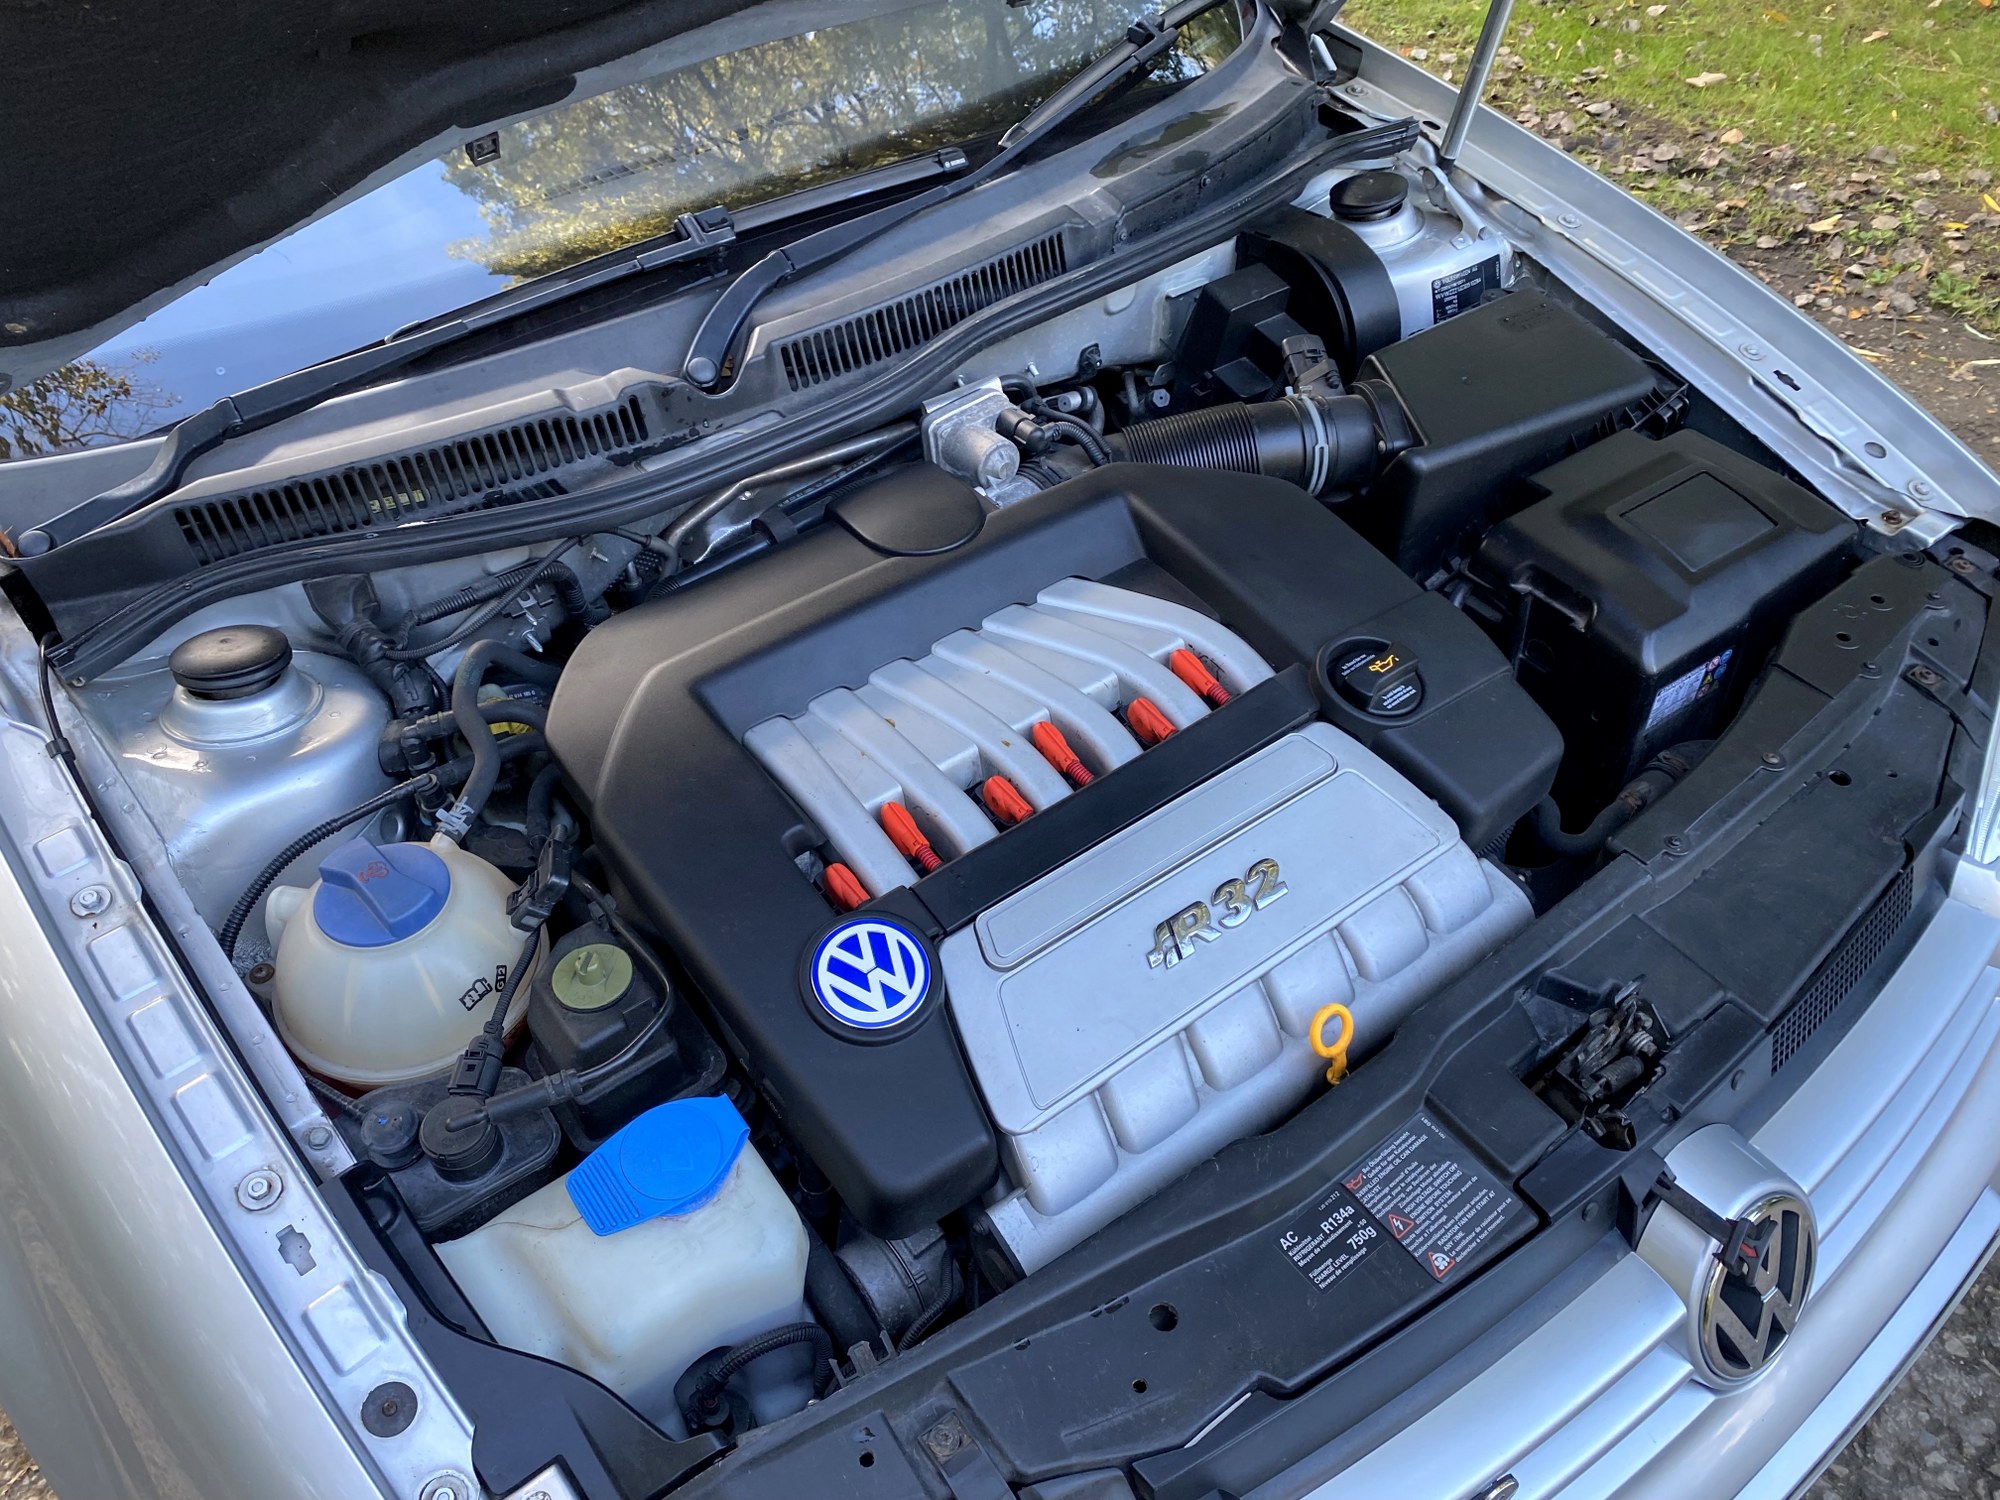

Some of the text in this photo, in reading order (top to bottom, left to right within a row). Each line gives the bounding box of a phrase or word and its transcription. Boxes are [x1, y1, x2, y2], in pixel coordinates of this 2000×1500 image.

[1147, 858, 1289, 969] R32
[496, 966, 506, 991] G12
[1378, 1164, 1394, 1179] ENGINE
[1409, 1134, 1428, 1151] DAMAGE
[1404, 1202, 1416, 1213] HIGH
[1433, 1171, 1450, 1187] SWITCH
[1409, 1171, 1462, 1219] ENGINE BEFORE TOUCHING
[1320, 1206, 1355, 1234] R134a
[1415, 1206, 1435, 1224] IGNITION
[1437, 1225, 1460, 1246] RADIATOR
[1476, 1196, 1490, 1210] START
[1280, 1231, 1298, 1250] AC
[1288, 1235, 1312, 1256] Kühlmittel
[1293, 1233, 1324, 1262] REFRIGERANT
[1298, 1253, 1315, 1267] Moyen
[1320, 1220, 1353, 1249] refroidissement
[1347, 1226, 1377, 1249] 750g
[1309, 1258, 1333, 1279] Füllmenge
[1314, 1254, 1349, 1283] CHARGE LEVEL
[1319, 1274, 1336, 1289] Niveau
[1341, 1247, 1367, 1270] remplissage
